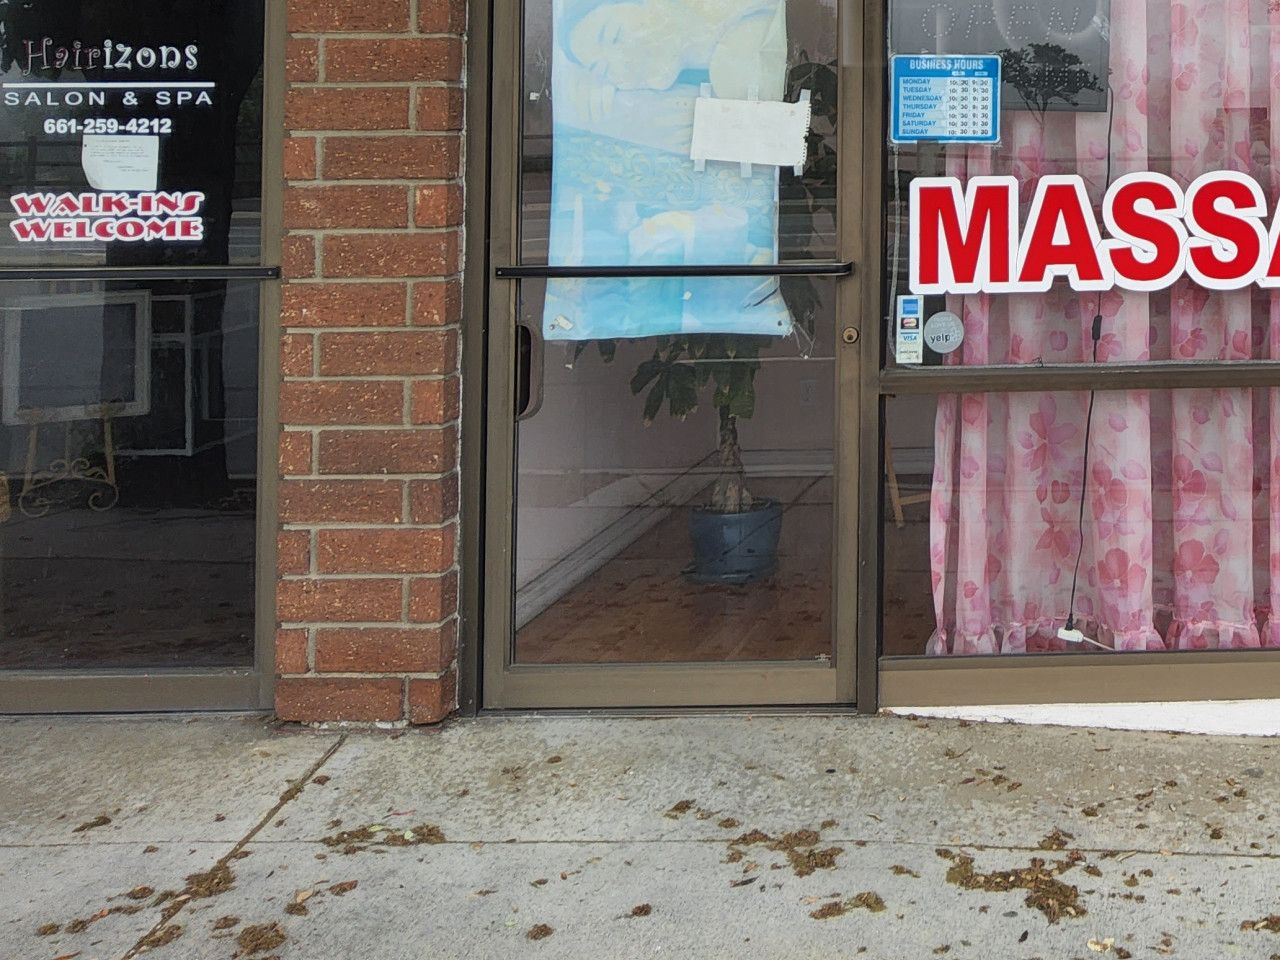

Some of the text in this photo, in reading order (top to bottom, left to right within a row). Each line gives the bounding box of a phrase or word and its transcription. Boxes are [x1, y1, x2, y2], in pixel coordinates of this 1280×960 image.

[921, 3, 1080, 41] OPEN
[22, 37, 199, 77] Hairizons
[909, 59, 984, 70] BUSINESS HOURS
[4, 91, 213, 106] SALON & SPA
[43, 118, 172, 134] 661-259-4212
[10, 191, 205, 216] WALK-INS
[10, 217, 203, 241] WELCOME
[930, 333, 951, 344] yelp
